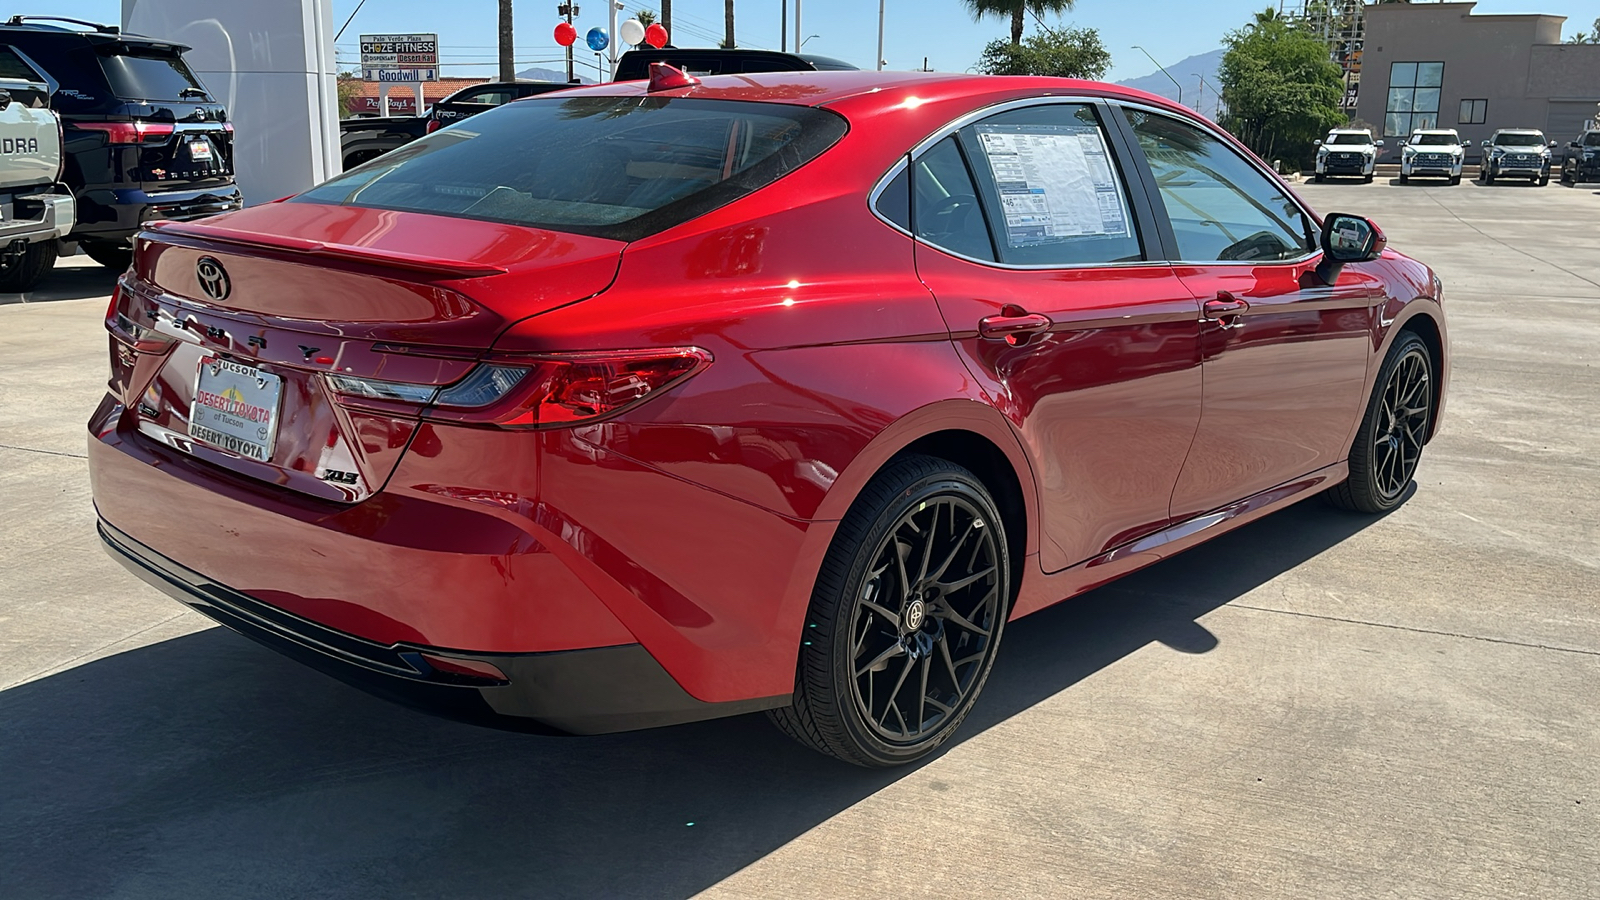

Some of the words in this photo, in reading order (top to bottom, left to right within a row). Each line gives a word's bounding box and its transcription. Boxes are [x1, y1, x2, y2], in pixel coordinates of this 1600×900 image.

[396, 42, 434, 52] FITNESS
[399, 54, 421, 62] Desert
[379, 69, 419, 81] Goodwill
[0, 138, 38, 154] DRA
[217, 360, 257, 377] TUCSON
[197, 390, 231, 412] DESERT
[233, 401, 270, 424] TOYOTA
[222, 414, 244, 429] Tucson
[191, 425, 223, 445] DESERT
[224, 436, 263, 460] TOYOTA
